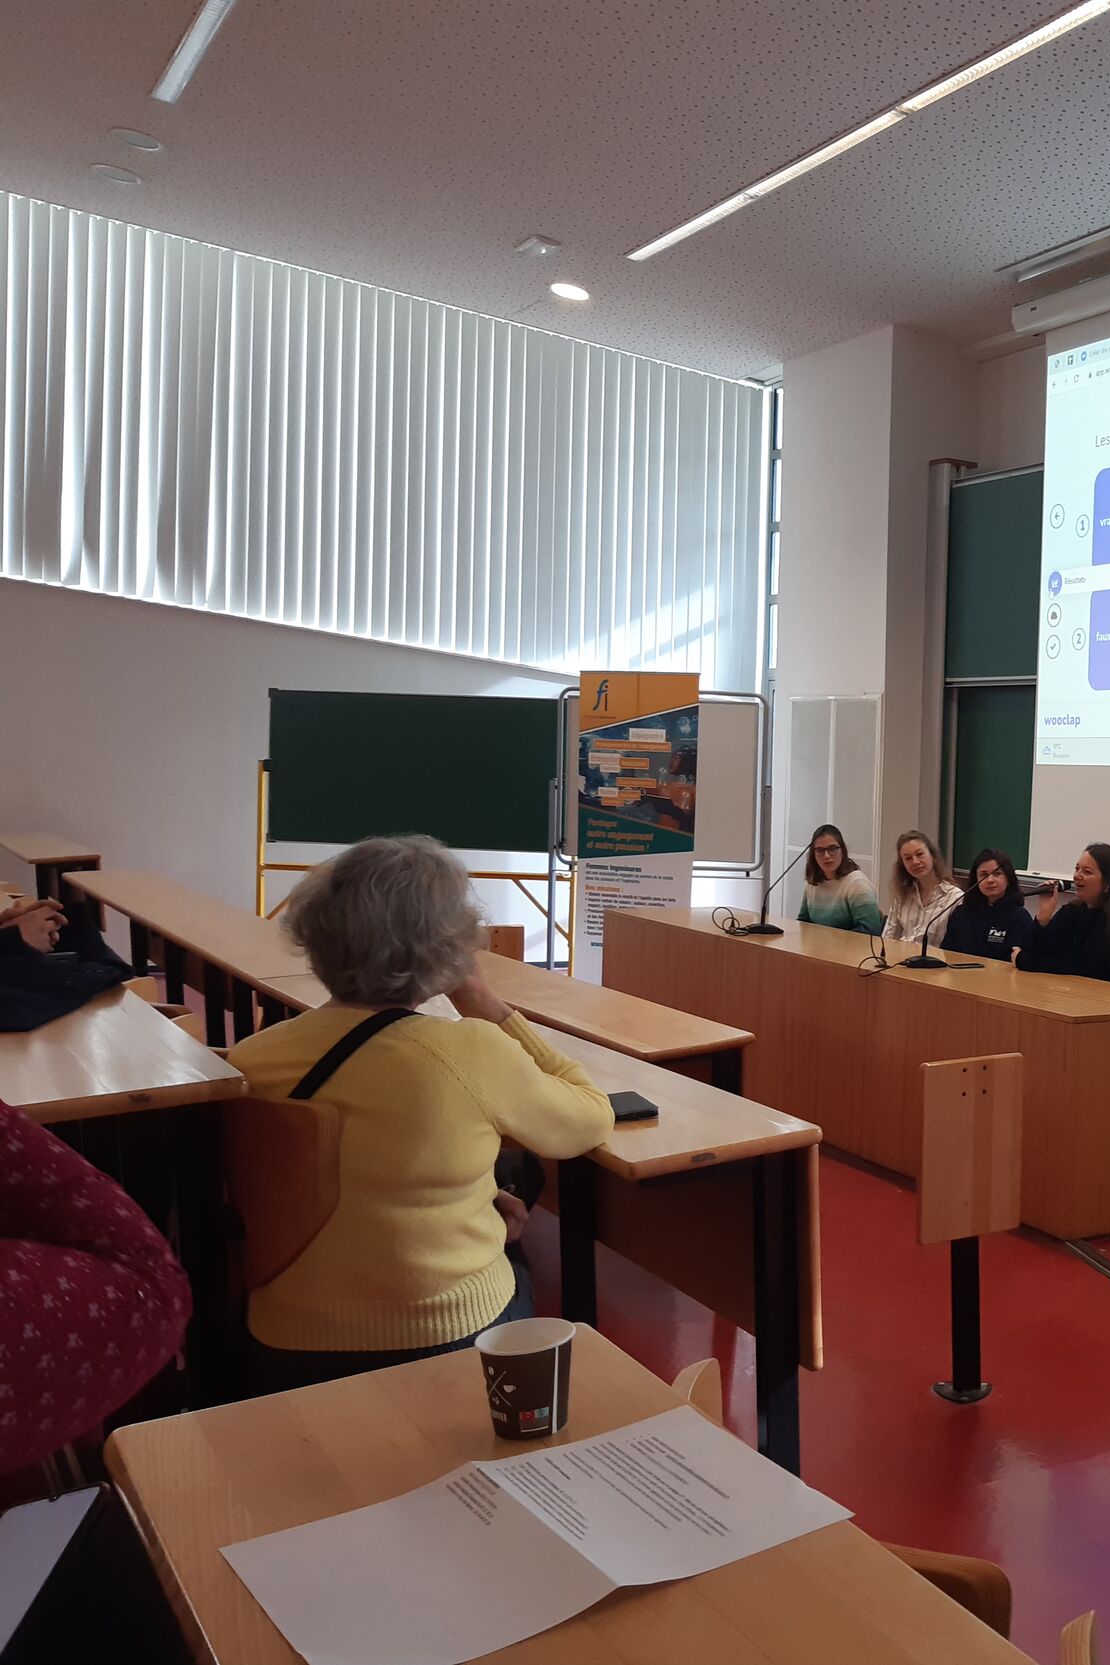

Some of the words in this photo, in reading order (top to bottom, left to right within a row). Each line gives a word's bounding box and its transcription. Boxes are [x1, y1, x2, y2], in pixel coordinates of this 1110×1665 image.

[1095, 435, 1110, 448] Les
[1080, 520, 1086, 531] 1
[1076, 633, 1082, 645] 2
[1044, 714, 1081, 728] wooclap
